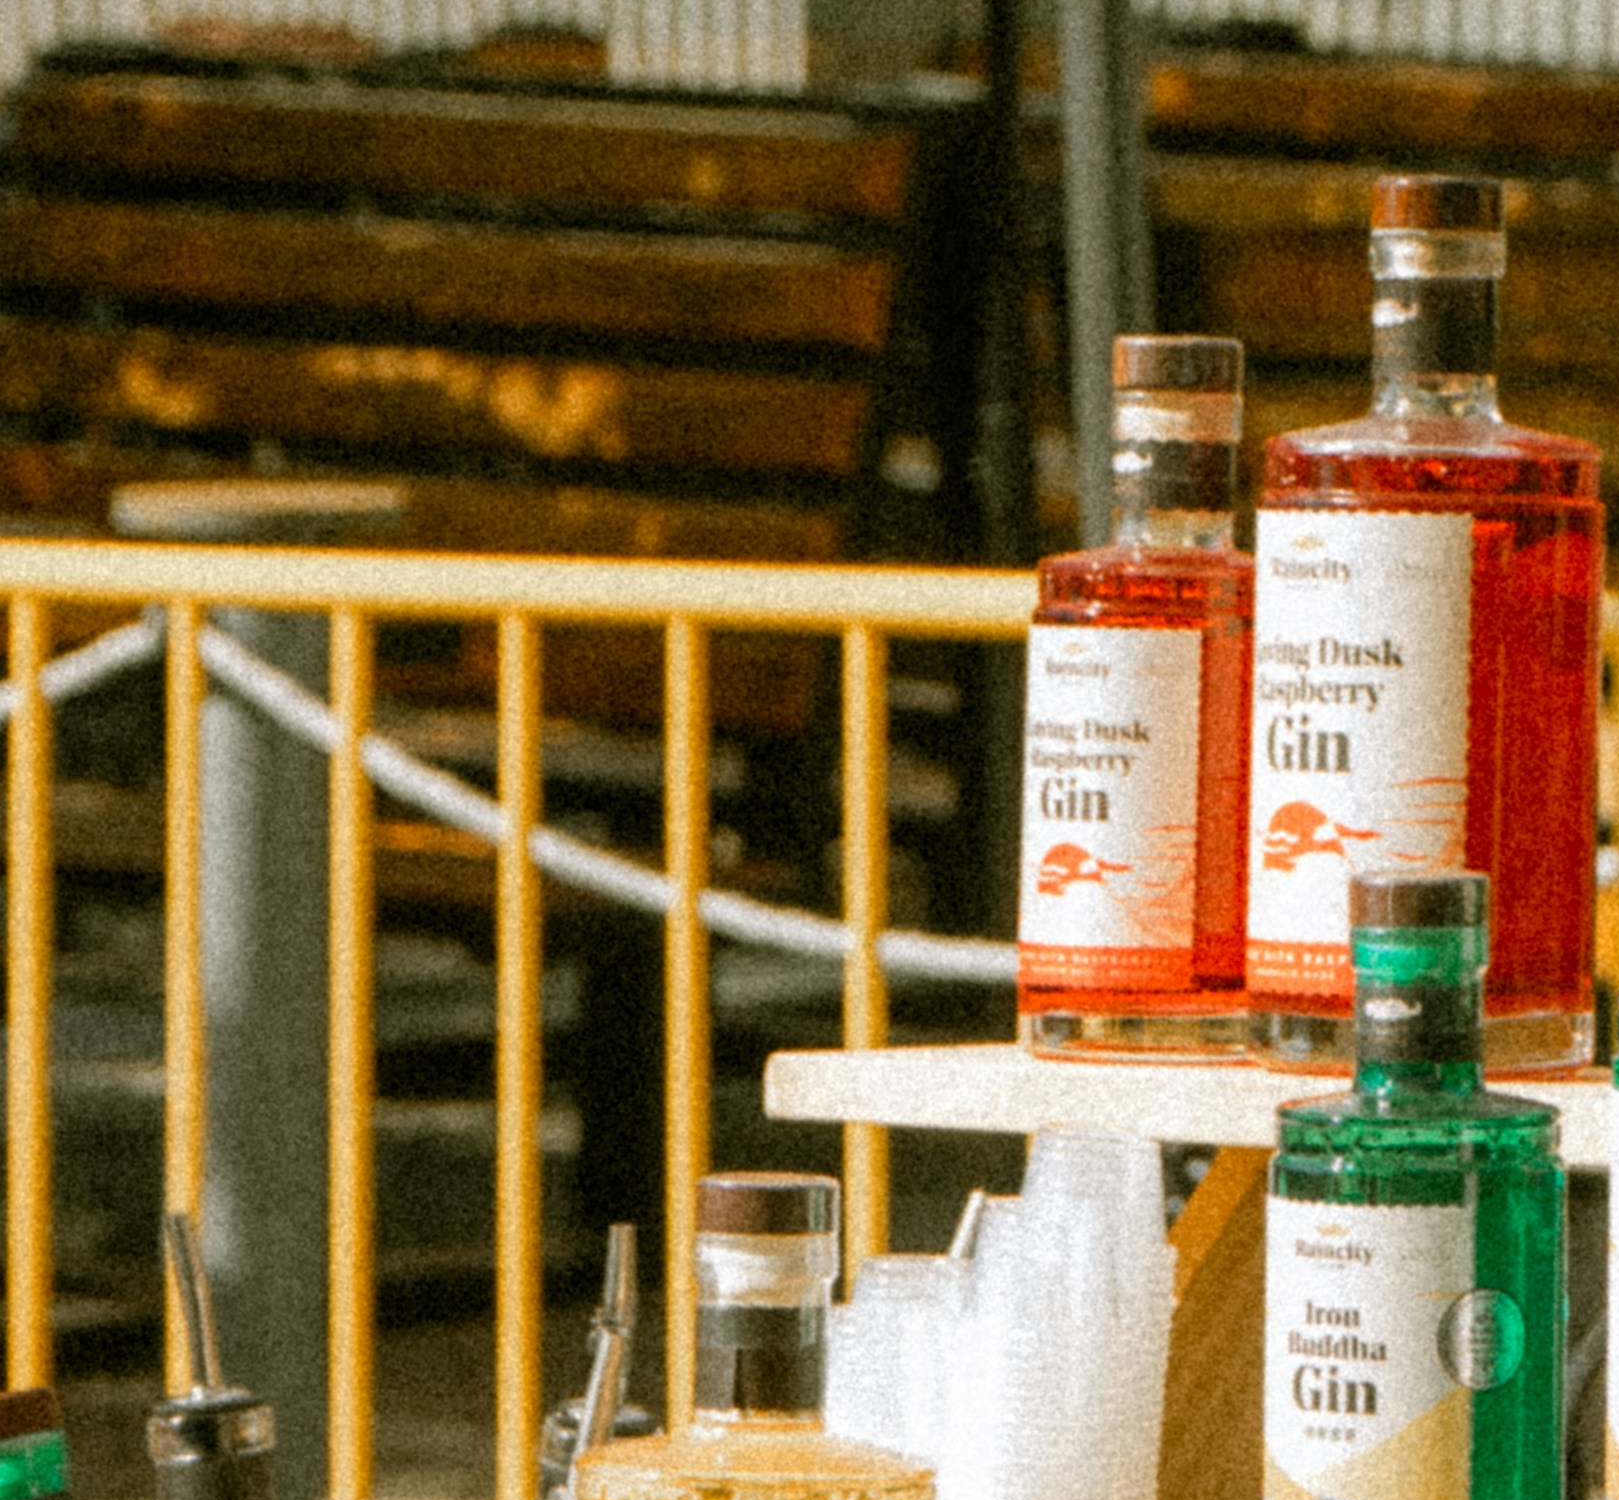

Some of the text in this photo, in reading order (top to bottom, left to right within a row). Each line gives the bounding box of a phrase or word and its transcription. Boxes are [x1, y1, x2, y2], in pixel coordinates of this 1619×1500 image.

[1318, 636, 1404, 669] Dusk
[1083, 718, 1151, 744] Dusk
[1266, 712, 1352, 774] Gin
[1039, 777, 1110, 822] Gin
[1294, 1239, 1375, 1266] Raincity
[1304, 1300, 1362, 1329] Iron
[1286, 1330, 1388, 1363] Buddha
[1291, 1363, 1379, 1416] Gin
